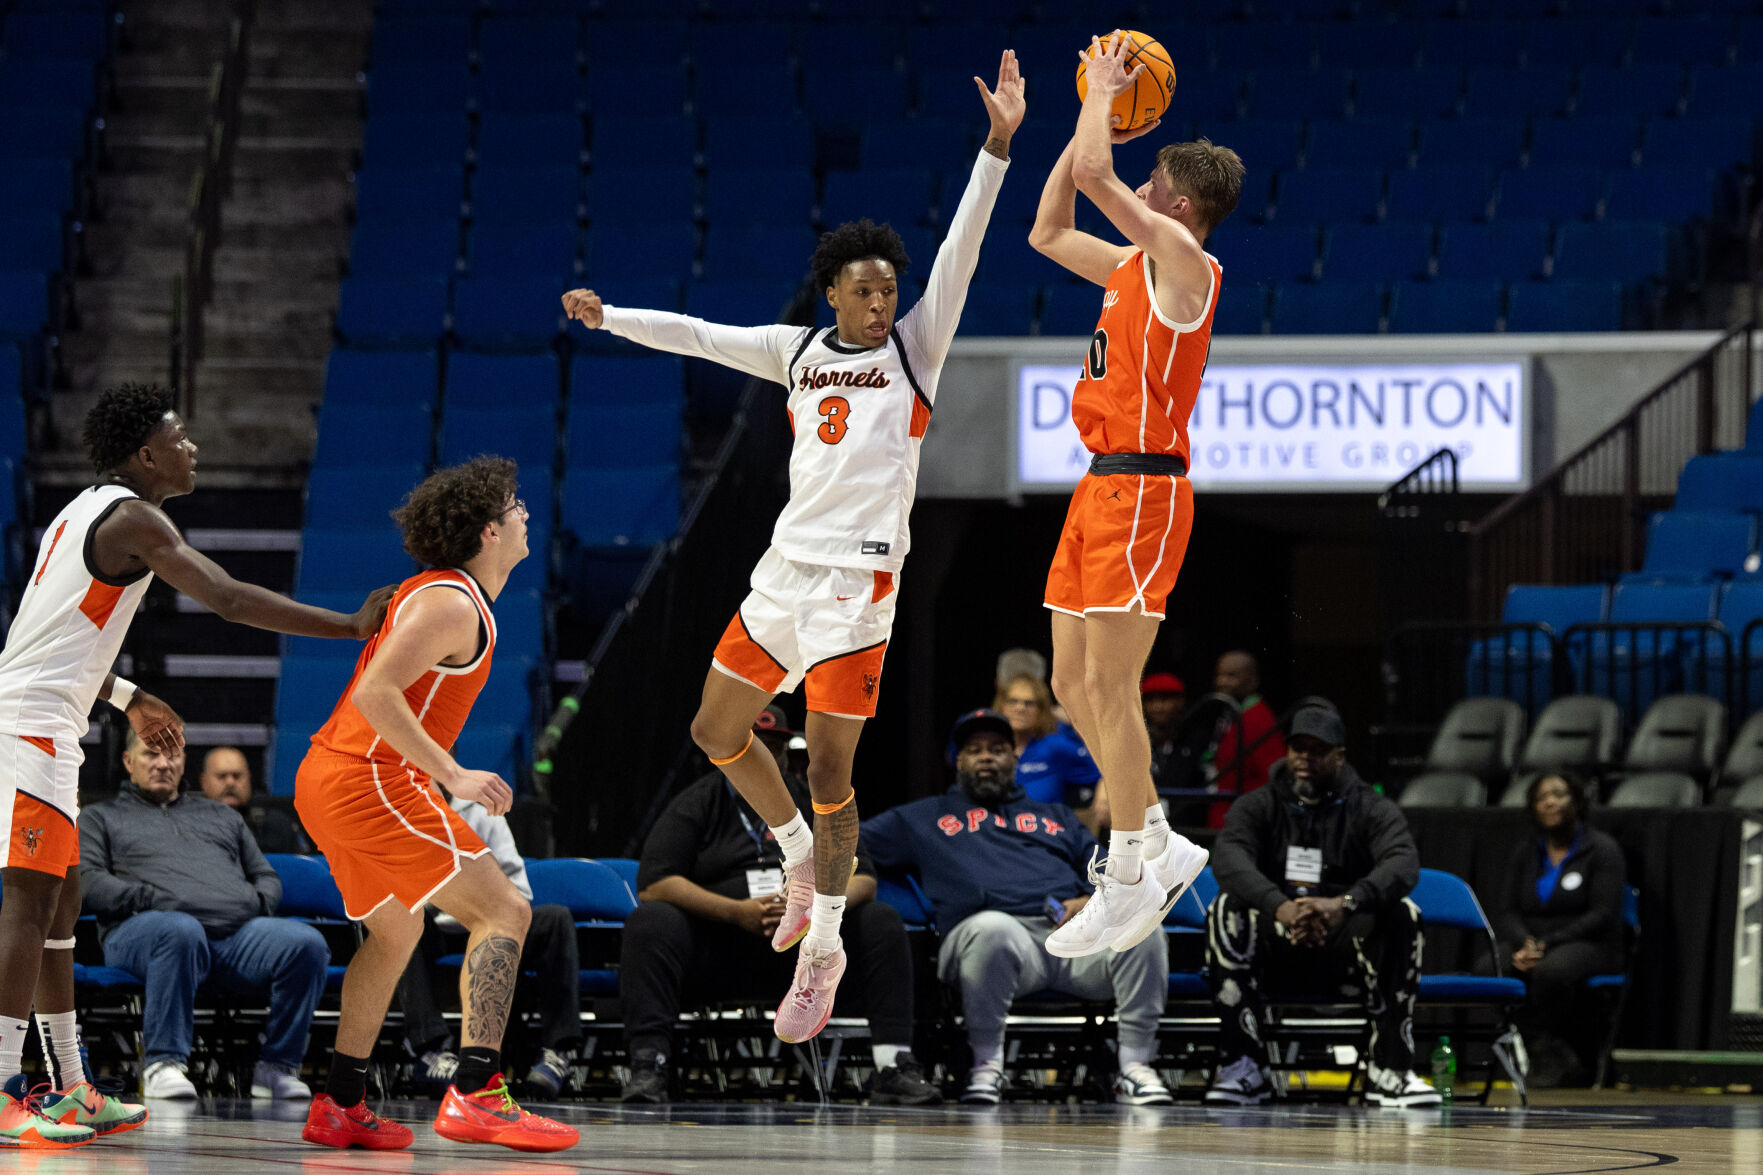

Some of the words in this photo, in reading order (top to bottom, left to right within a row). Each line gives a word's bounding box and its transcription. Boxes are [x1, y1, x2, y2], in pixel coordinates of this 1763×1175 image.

[799, 366, 890, 392] Hornets
[817, 395, 851, 445] 3
[33, 519, 69, 588] 1
